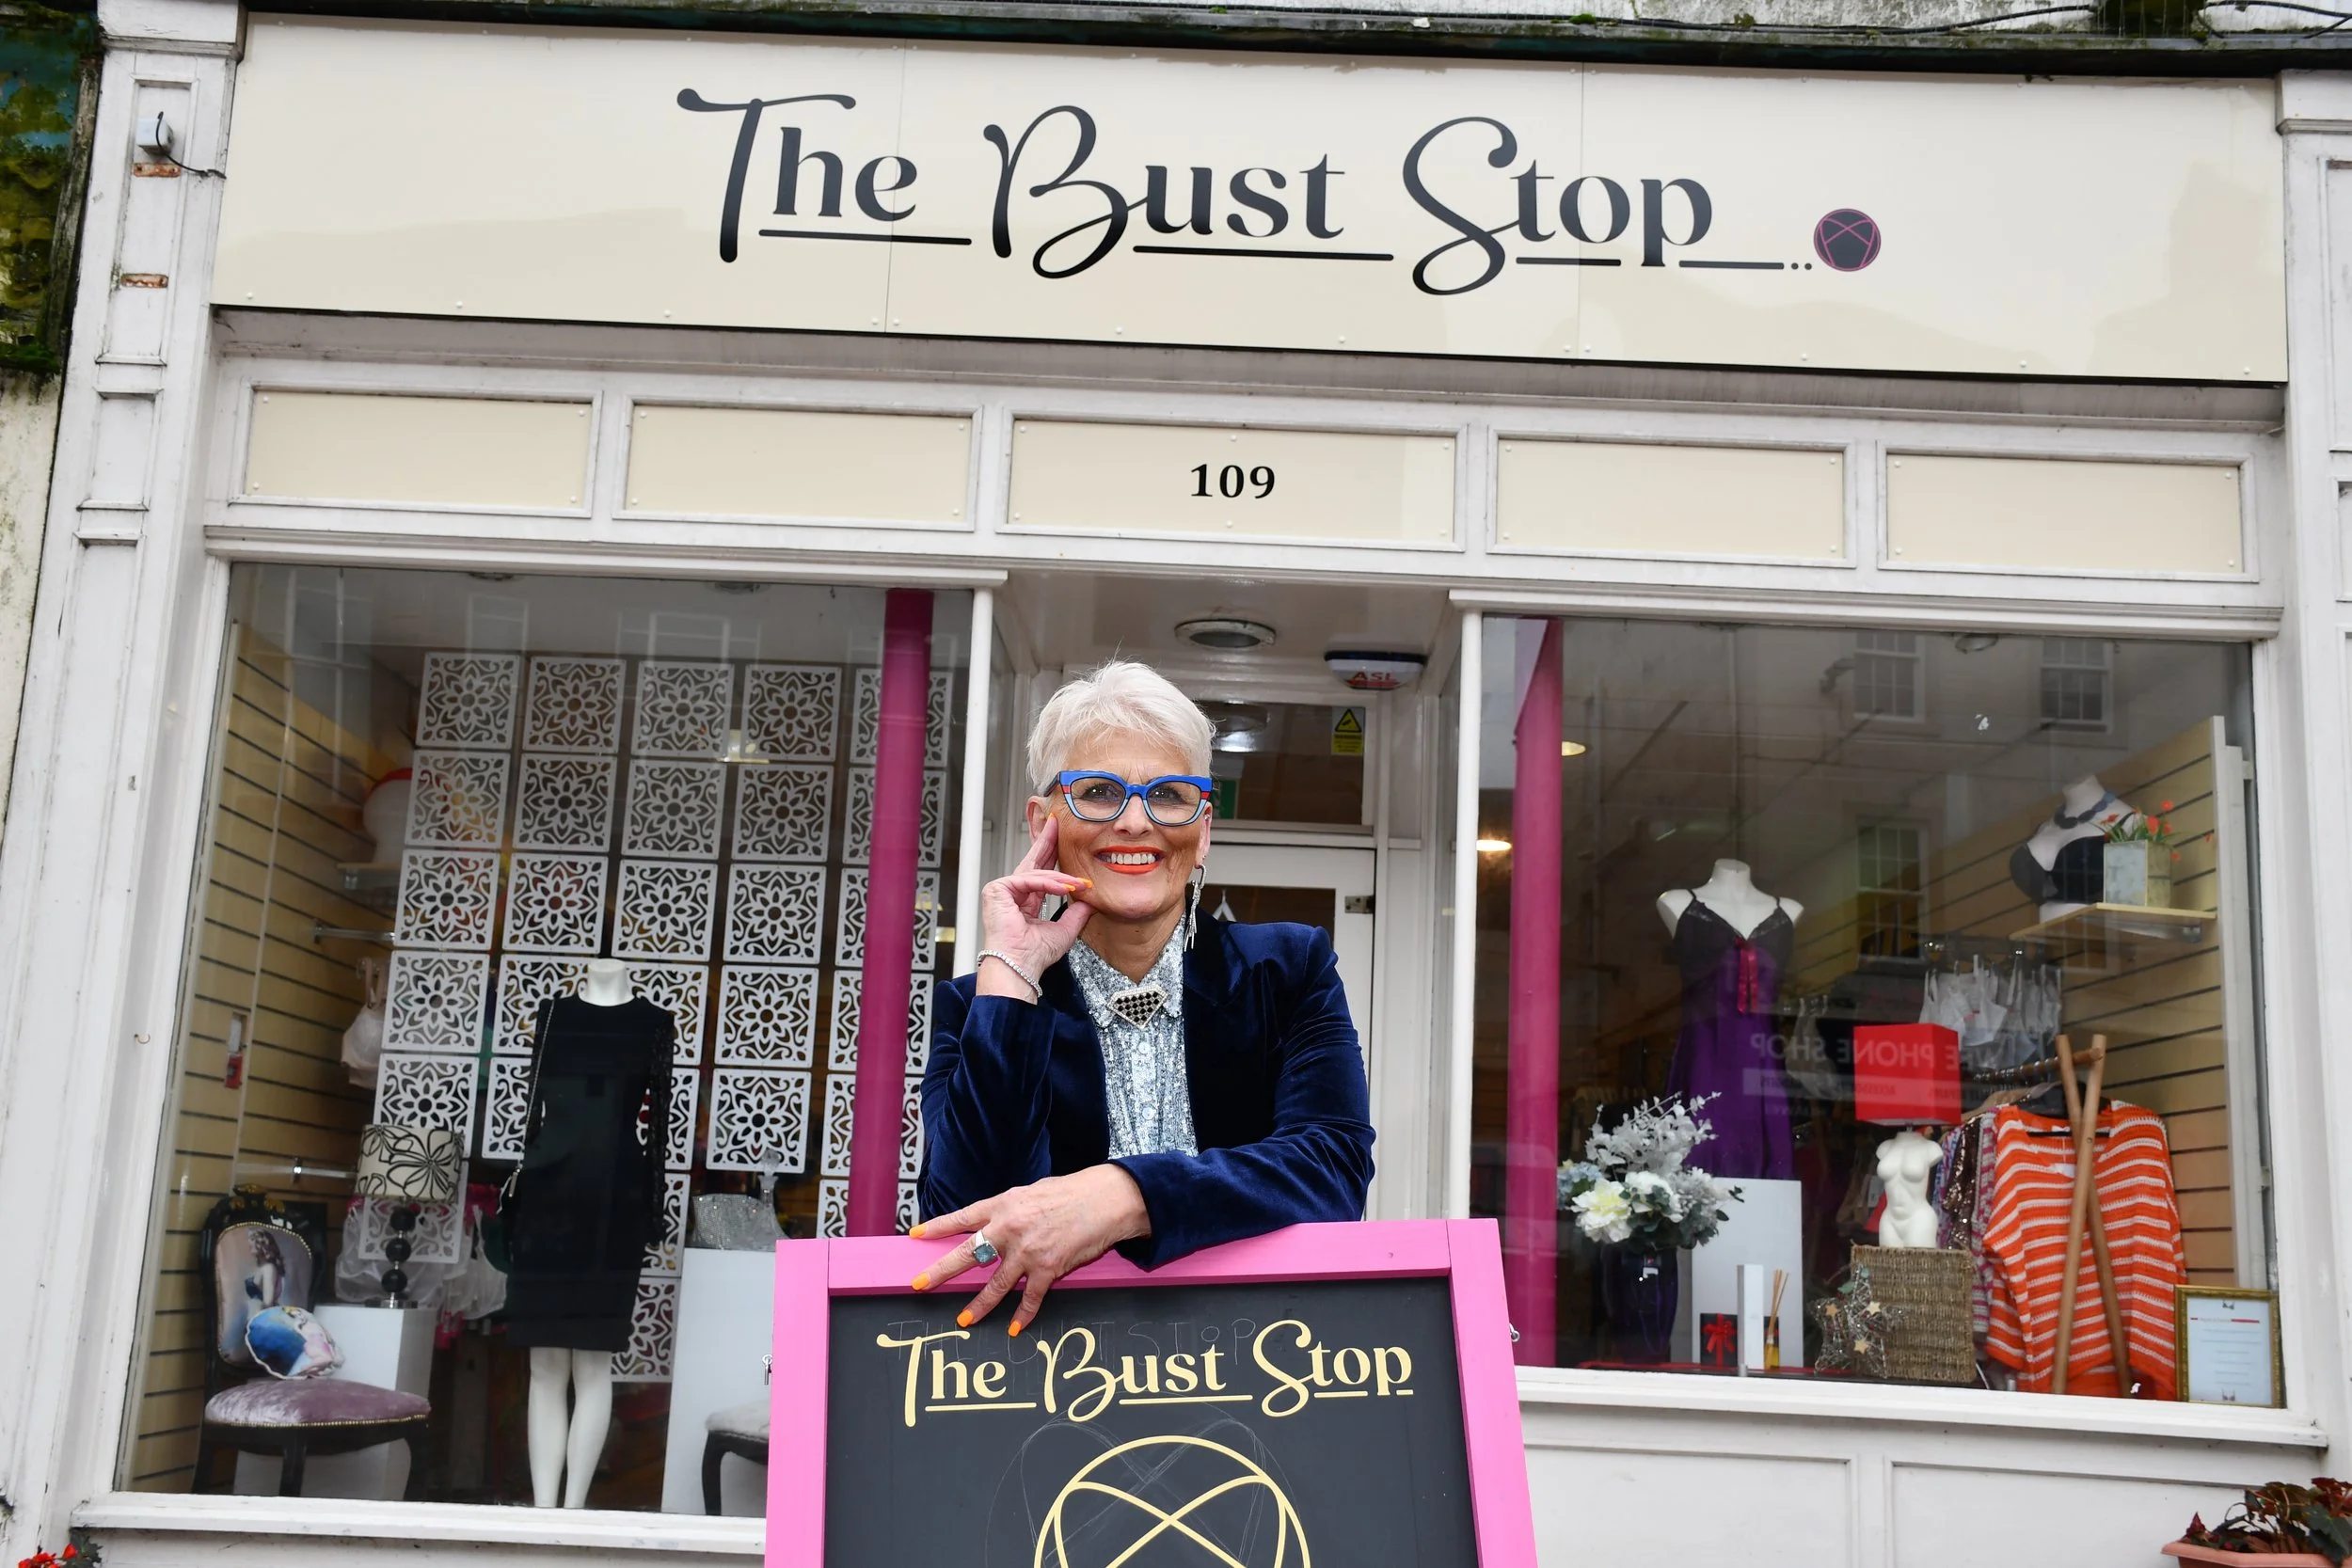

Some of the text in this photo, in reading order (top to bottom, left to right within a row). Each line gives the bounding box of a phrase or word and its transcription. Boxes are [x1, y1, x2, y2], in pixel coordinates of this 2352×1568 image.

[676, 87, 1713, 296] The Bust Stop
[1191, 463, 1276, 499] 109
[876, 1319, 1412, 1428] The Bust Stop
